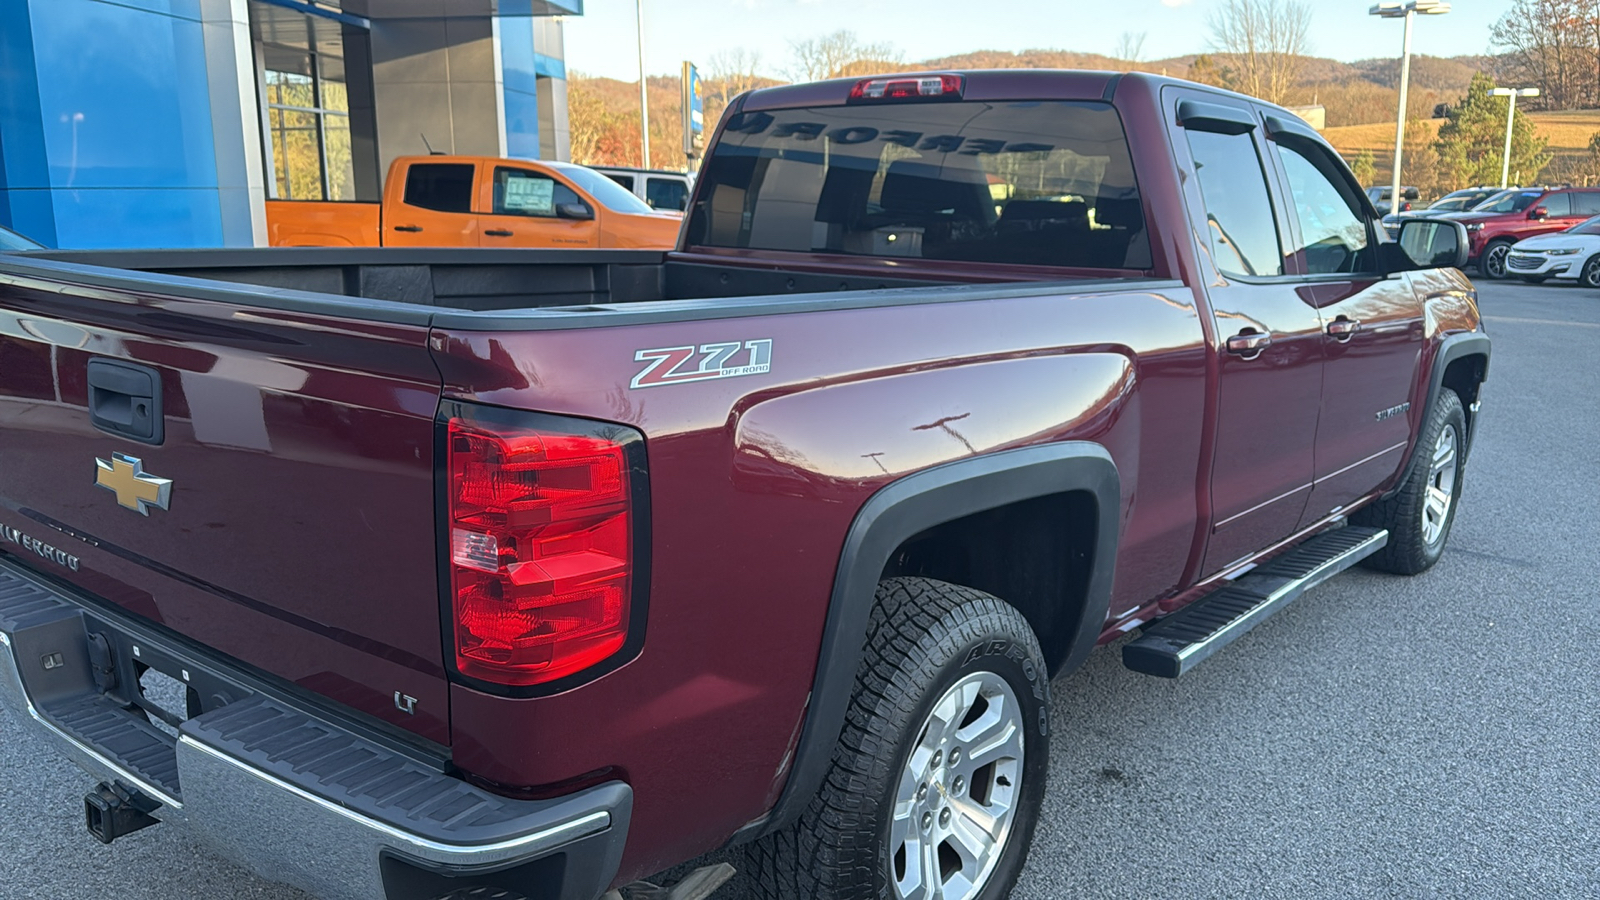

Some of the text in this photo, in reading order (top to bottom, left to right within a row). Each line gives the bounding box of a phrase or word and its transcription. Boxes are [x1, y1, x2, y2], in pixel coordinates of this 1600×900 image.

[630, 338, 773, 389] Z71
[721, 364, 769, 376] OFF ROAD
[394, 690, 418, 715] LT
